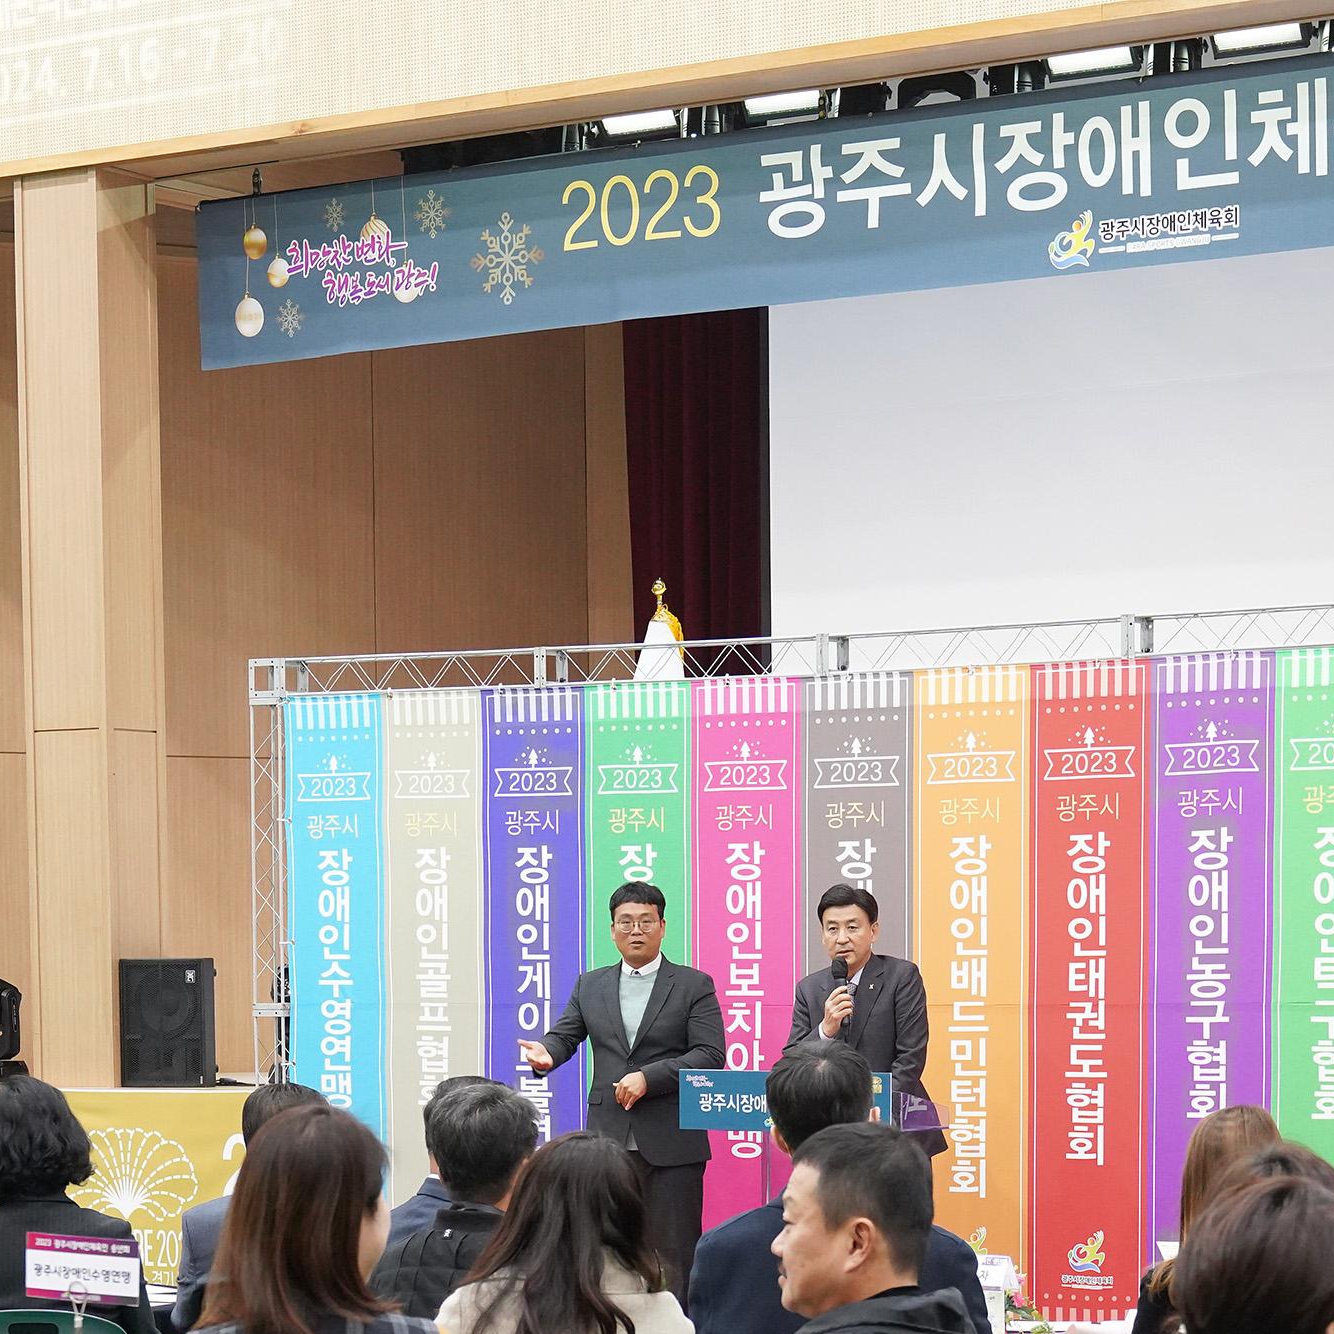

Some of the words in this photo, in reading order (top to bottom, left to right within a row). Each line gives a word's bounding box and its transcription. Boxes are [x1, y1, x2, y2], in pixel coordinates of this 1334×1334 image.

[562, 164, 720, 254] 2023
[1100, 206, 1240, 241] 광주시장애인체육회
[286, 234, 352, 279] 희망찬
[392, 258, 439, 292] 광주!
[943, 755, 998, 778] 2023
[1060, 751, 1118, 775] 2023
[1182, 745, 1241, 769] 2023
[408, 776, 456, 795] 2023
[508, 772, 557, 792] 2023
[612, 768, 663, 790] 2023
[718, 765, 771, 787] 2023
[829, 761, 883, 783] 2023
[310, 777, 357, 798] 2023
[824, 800, 886, 830] 광주시
[937, 796, 1001, 826] 광주시
[1055, 791, 1121, 823] 광주시
[1176, 786, 1244, 818] 광주시
[306, 813, 359, 839] 광주시
[404, 810, 458, 838] 광주시
[504, 808, 560, 836] 광주시
[607, 806, 666, 834] 광주시
[714, 803, 774, 833] 광주시
[316, 848, 354, 1108] 장애인수영연맹
[1185, 826, 1234, 1119] 장애인농구협회
[1065, 831, 1111, 1167] 장애인태권도협회
[948, 834, 992, 1199] 장애인배드민턴협회
[698, 1092, 768, 1114] 광주시장애
[34, 1263, 132, 1285] 광주시장애인수영연맹
